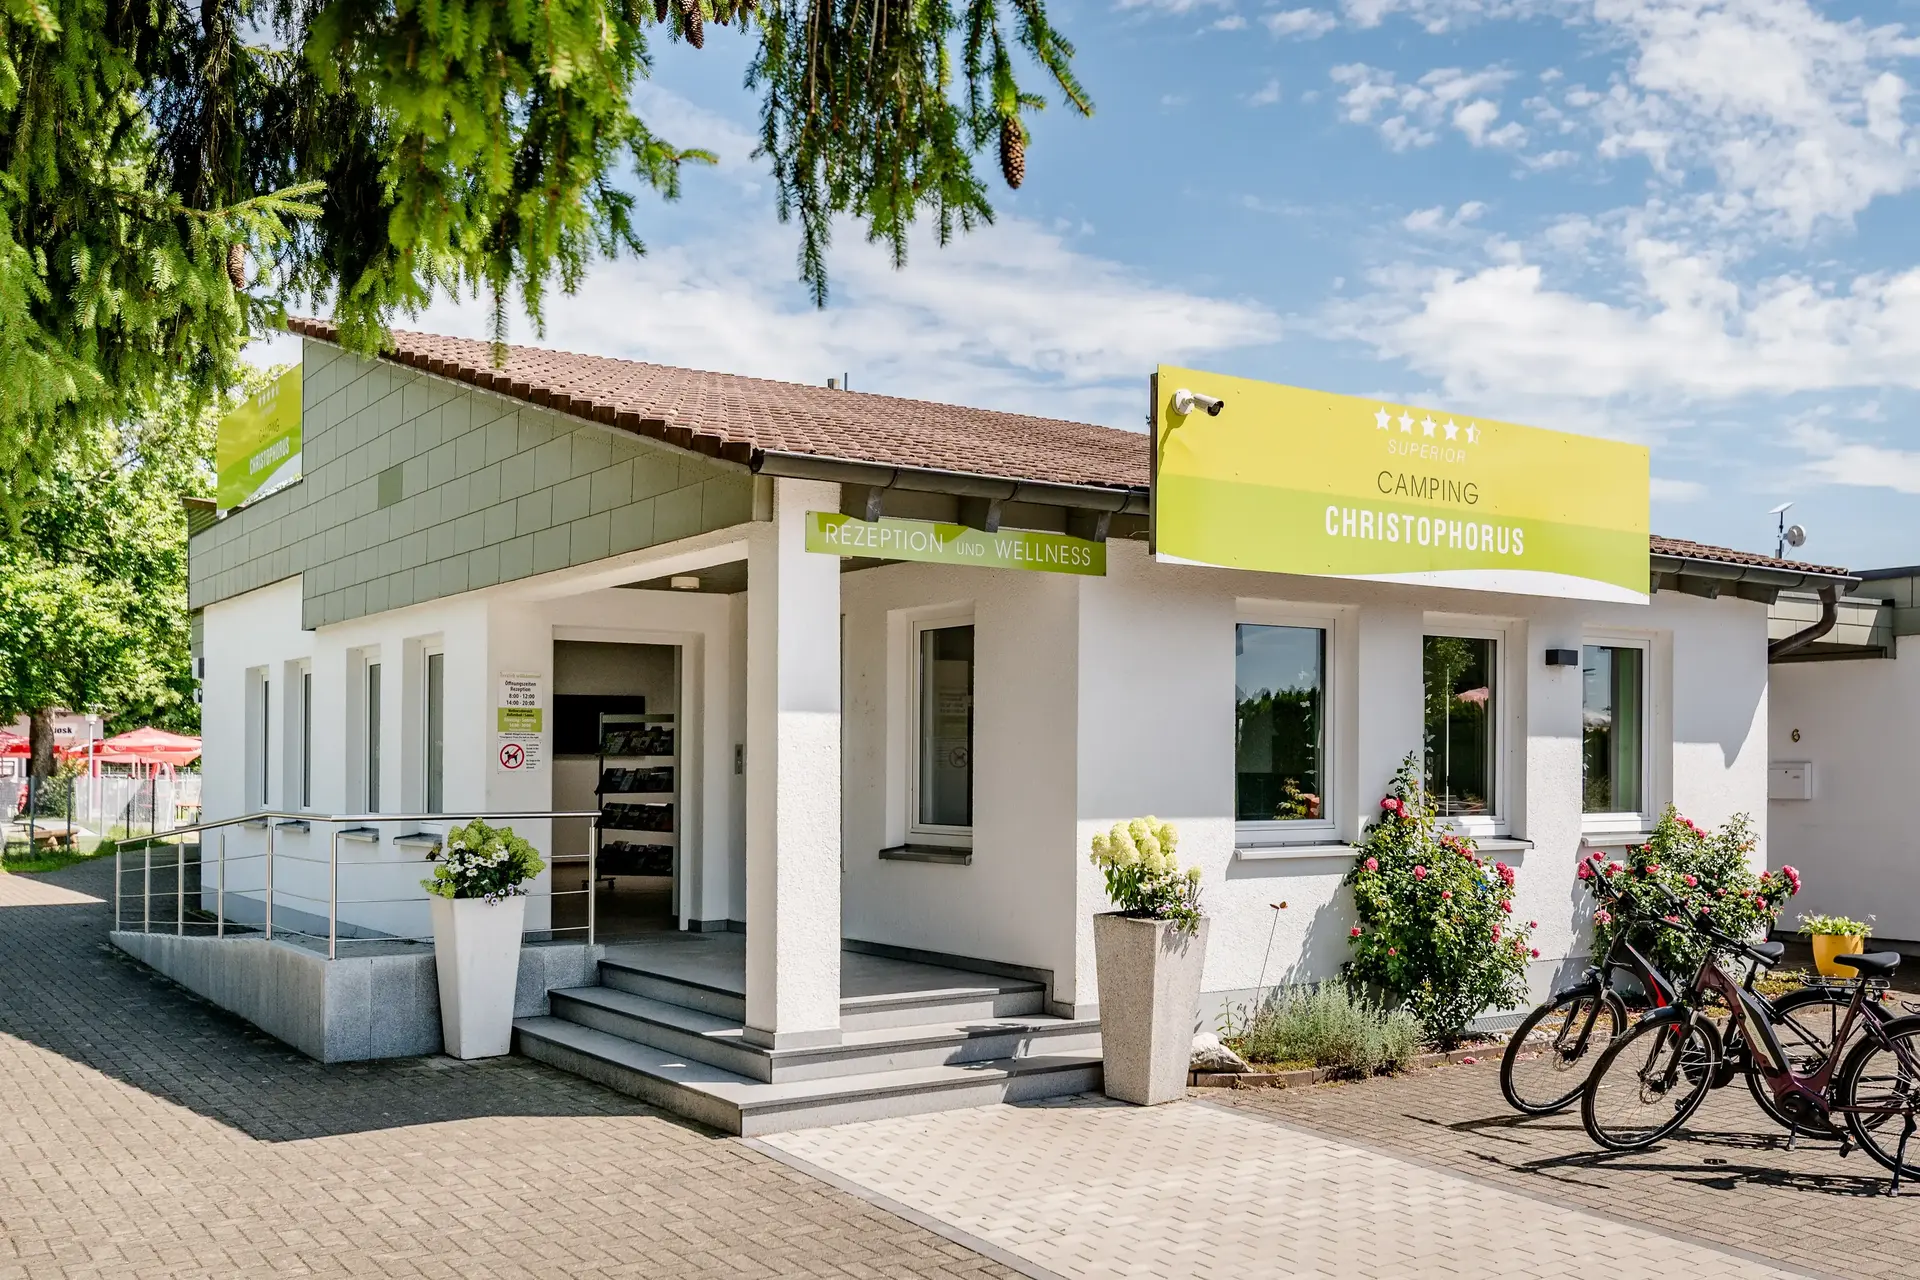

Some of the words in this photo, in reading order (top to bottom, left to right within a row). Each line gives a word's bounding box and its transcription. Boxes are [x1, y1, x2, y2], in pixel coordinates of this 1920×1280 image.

[249, 436, 290, 475] CHRISTOPHORUS
[1388, 439, 1466, 463] SUPERIOR
[1377, 470, 1479, 505] CAMPING
[825, 523, 943, 553] REZEPTION
[956, 541, 985, 557] UND
[994, 539, 1091, 567] WELLNESS
[1325, 505, 1525, 556] CHRISTOPHORUS
[54, 726, 73, 734] iosk
[1791, 728, 1801, 743] 6
